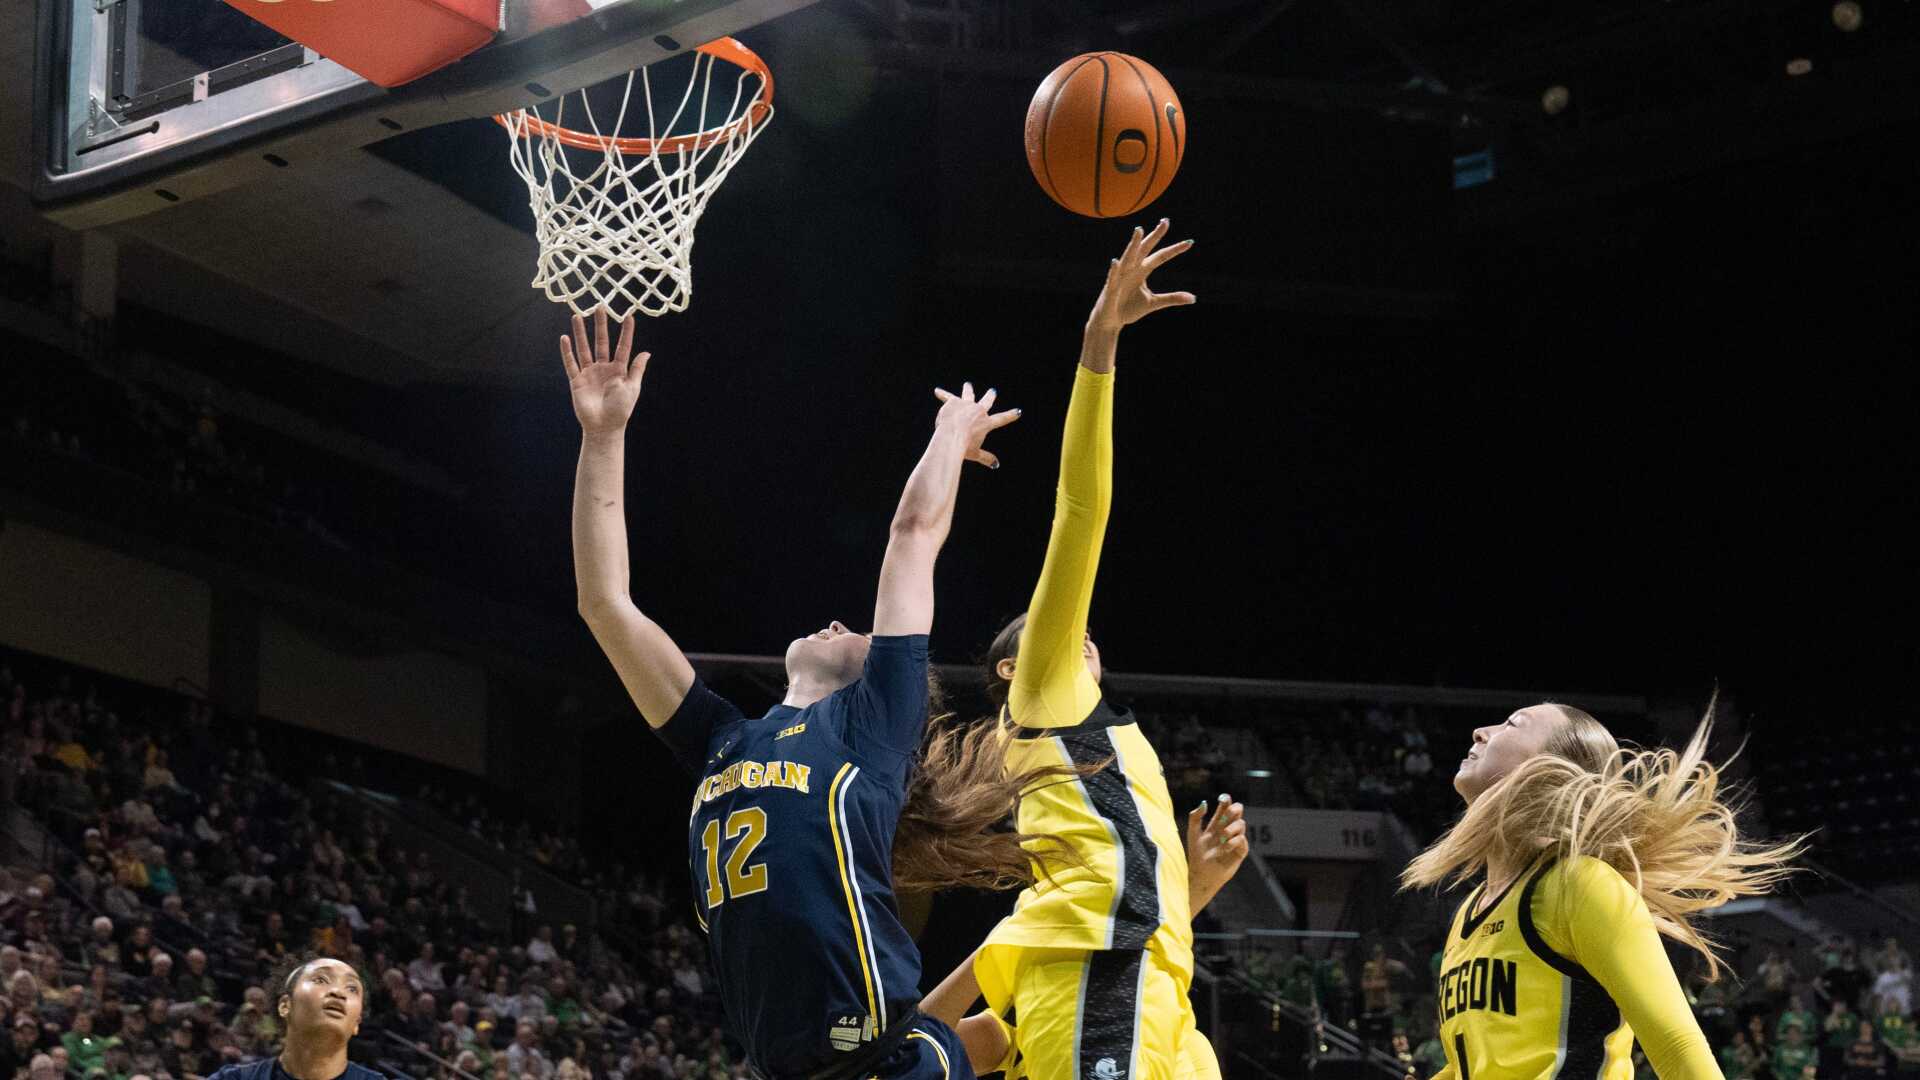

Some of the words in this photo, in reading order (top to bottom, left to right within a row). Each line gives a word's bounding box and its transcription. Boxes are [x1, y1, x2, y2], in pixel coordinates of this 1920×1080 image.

[1114, 129, 1148, 173] O
[702, 806, 768, 909] 12
[1249, 825, 1273, 845] 15
[1440, 957, 1517, 1024] REGON
